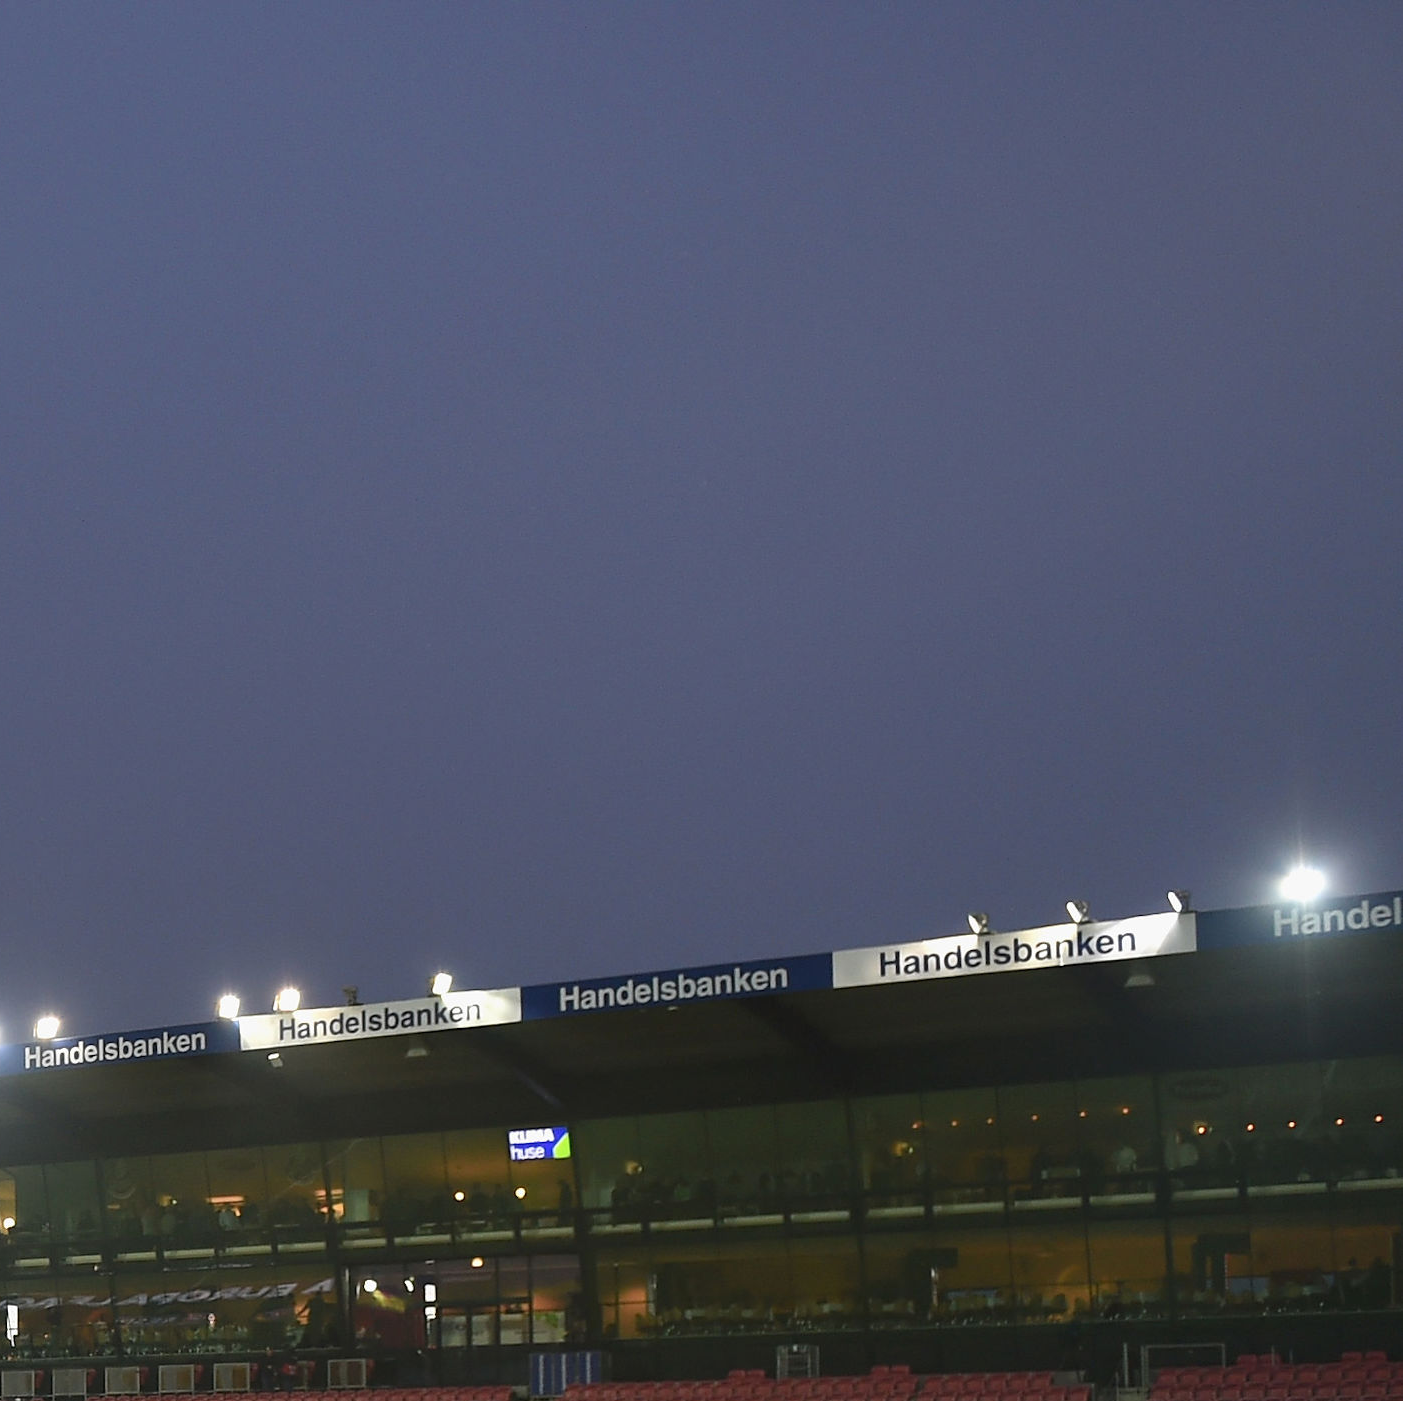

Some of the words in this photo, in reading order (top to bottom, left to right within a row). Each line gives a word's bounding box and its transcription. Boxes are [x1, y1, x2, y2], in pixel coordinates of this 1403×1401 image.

[878, 928, 1137, 978] Handelsbanken
[559, 966, 789, 1013] Handelsbanken
[279, 1001, 482, 1042] Handelsbanken
[24, 1031, 207, 1070] Handelsbanken
[510, 1145, 545, 1160] huse
